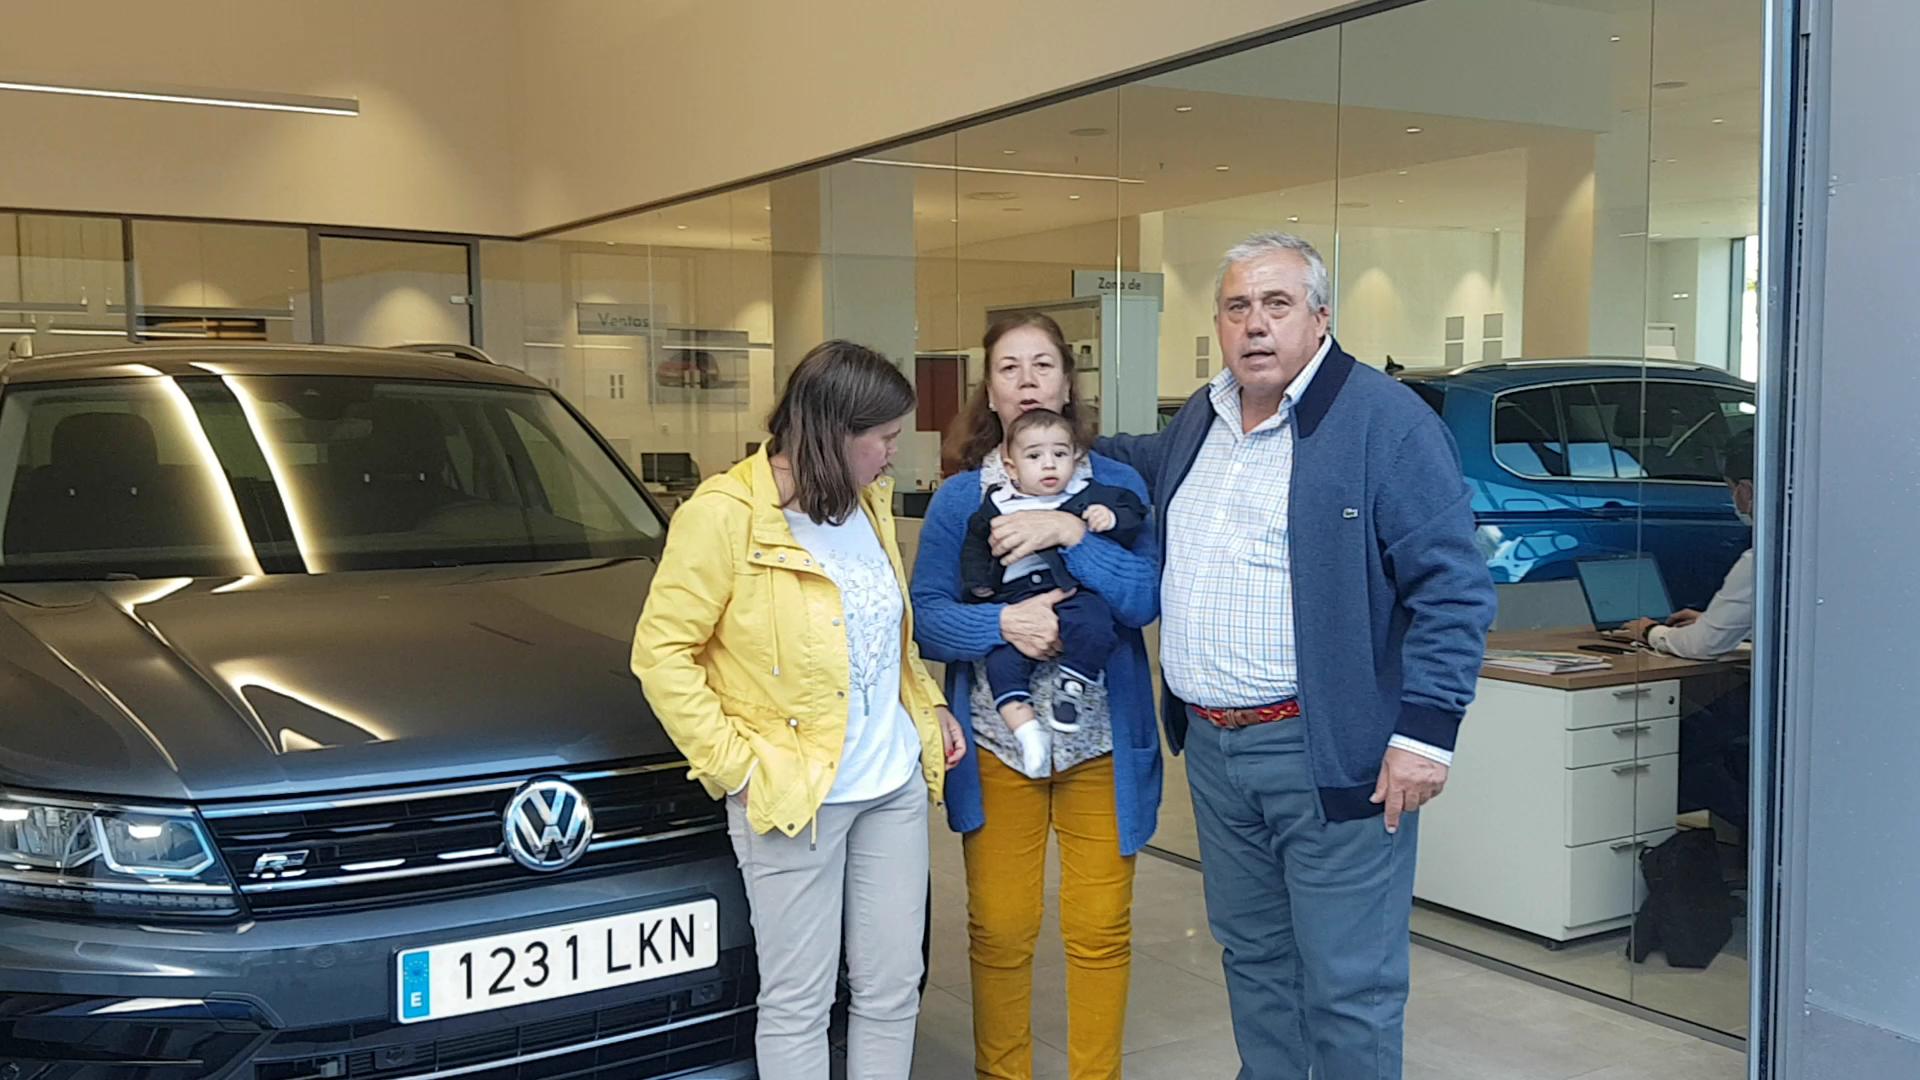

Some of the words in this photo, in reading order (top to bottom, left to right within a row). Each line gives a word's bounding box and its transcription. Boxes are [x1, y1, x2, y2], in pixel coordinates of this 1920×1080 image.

[1128, 278, 1142, 290] de
[597, 312, 649, 328] Ventas
[459, 934, 578, 1000] 1231
[607, 913, 694, 973] LKN
[410, 991, 423, 1008] E
